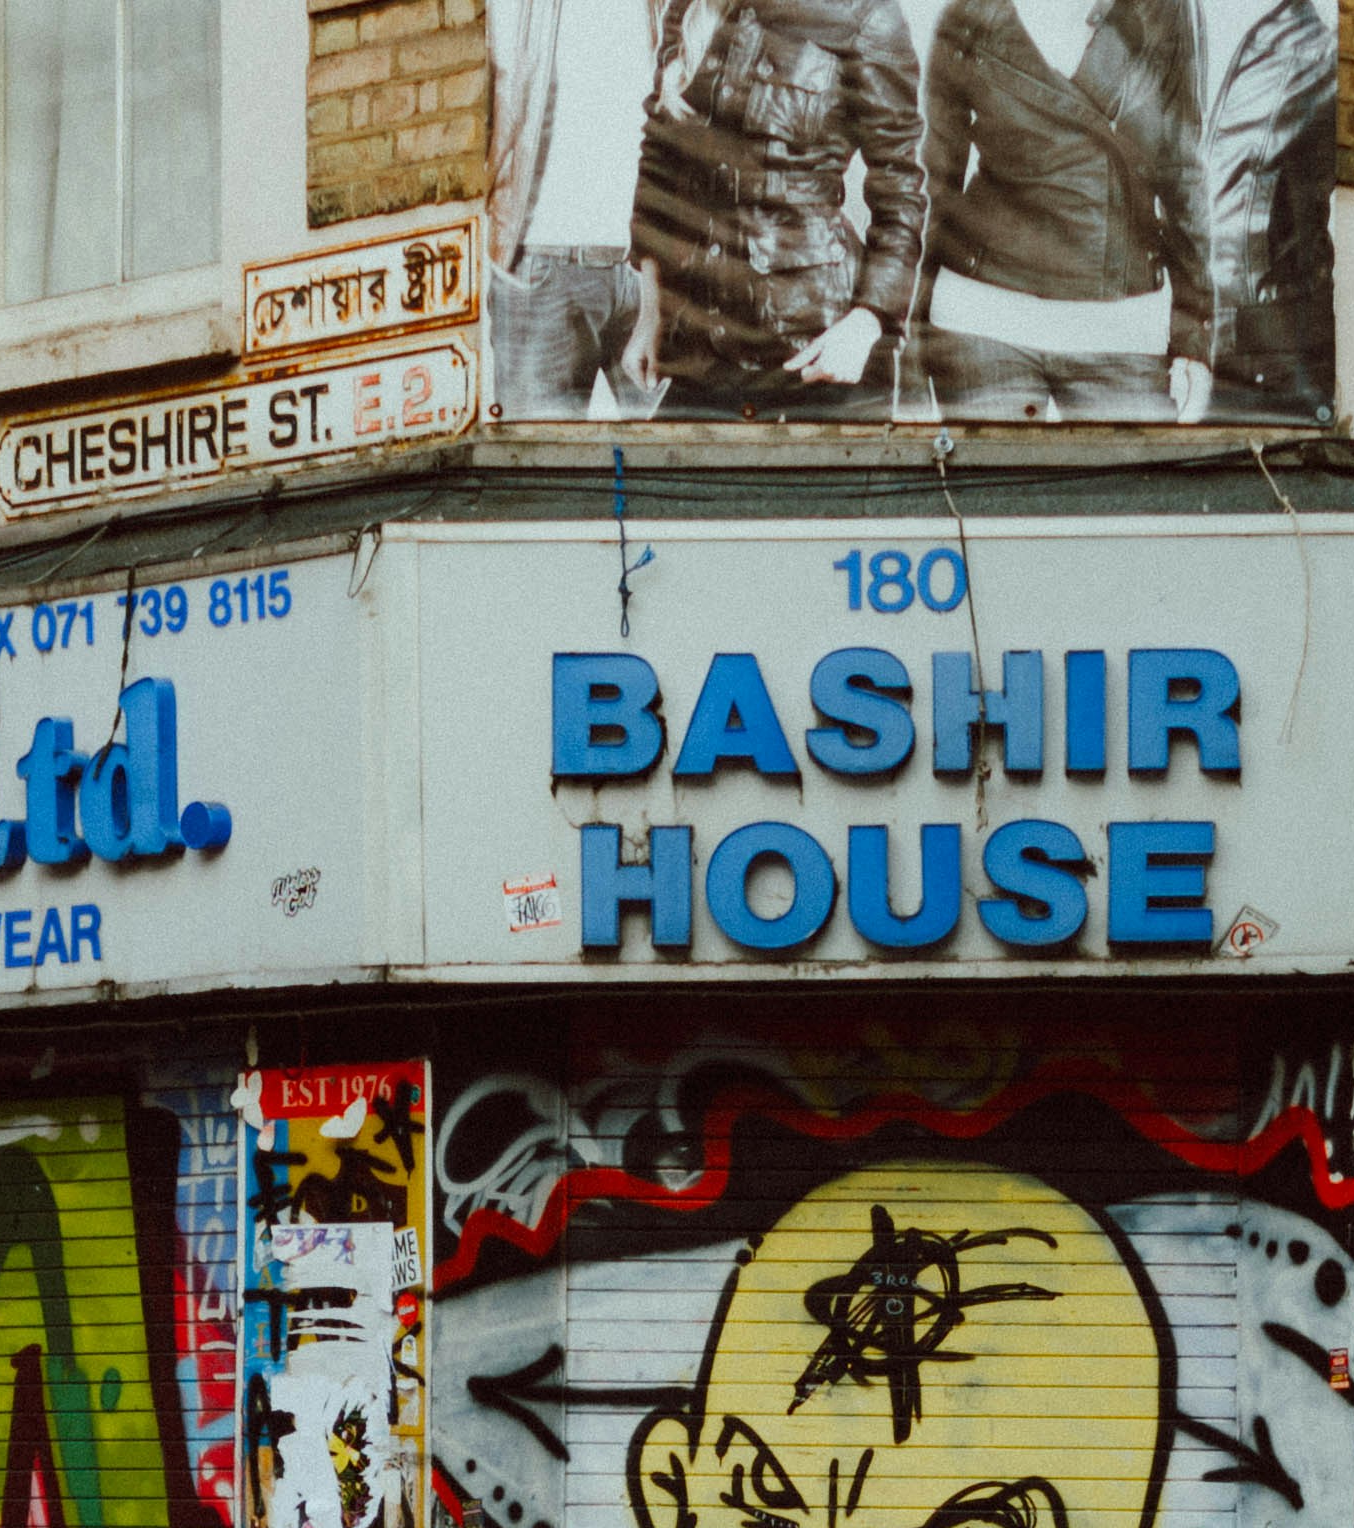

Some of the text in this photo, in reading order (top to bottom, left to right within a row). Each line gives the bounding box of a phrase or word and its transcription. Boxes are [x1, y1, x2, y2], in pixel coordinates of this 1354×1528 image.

[13, 399, 249, 492] CHESHIRE
[268, 383, 333, 448] ST.
[33, 603, 96, 651] 071
[117, 586, 189, 637] 739
[209, 570, 293, 627] 8115
[832, 548, 968, 613] 180
[551, 646, 1243, 781] BASHIR
[580, 820, 1215, 953] HOUSE
[282, 1074, 392, 1107] EST 1976
